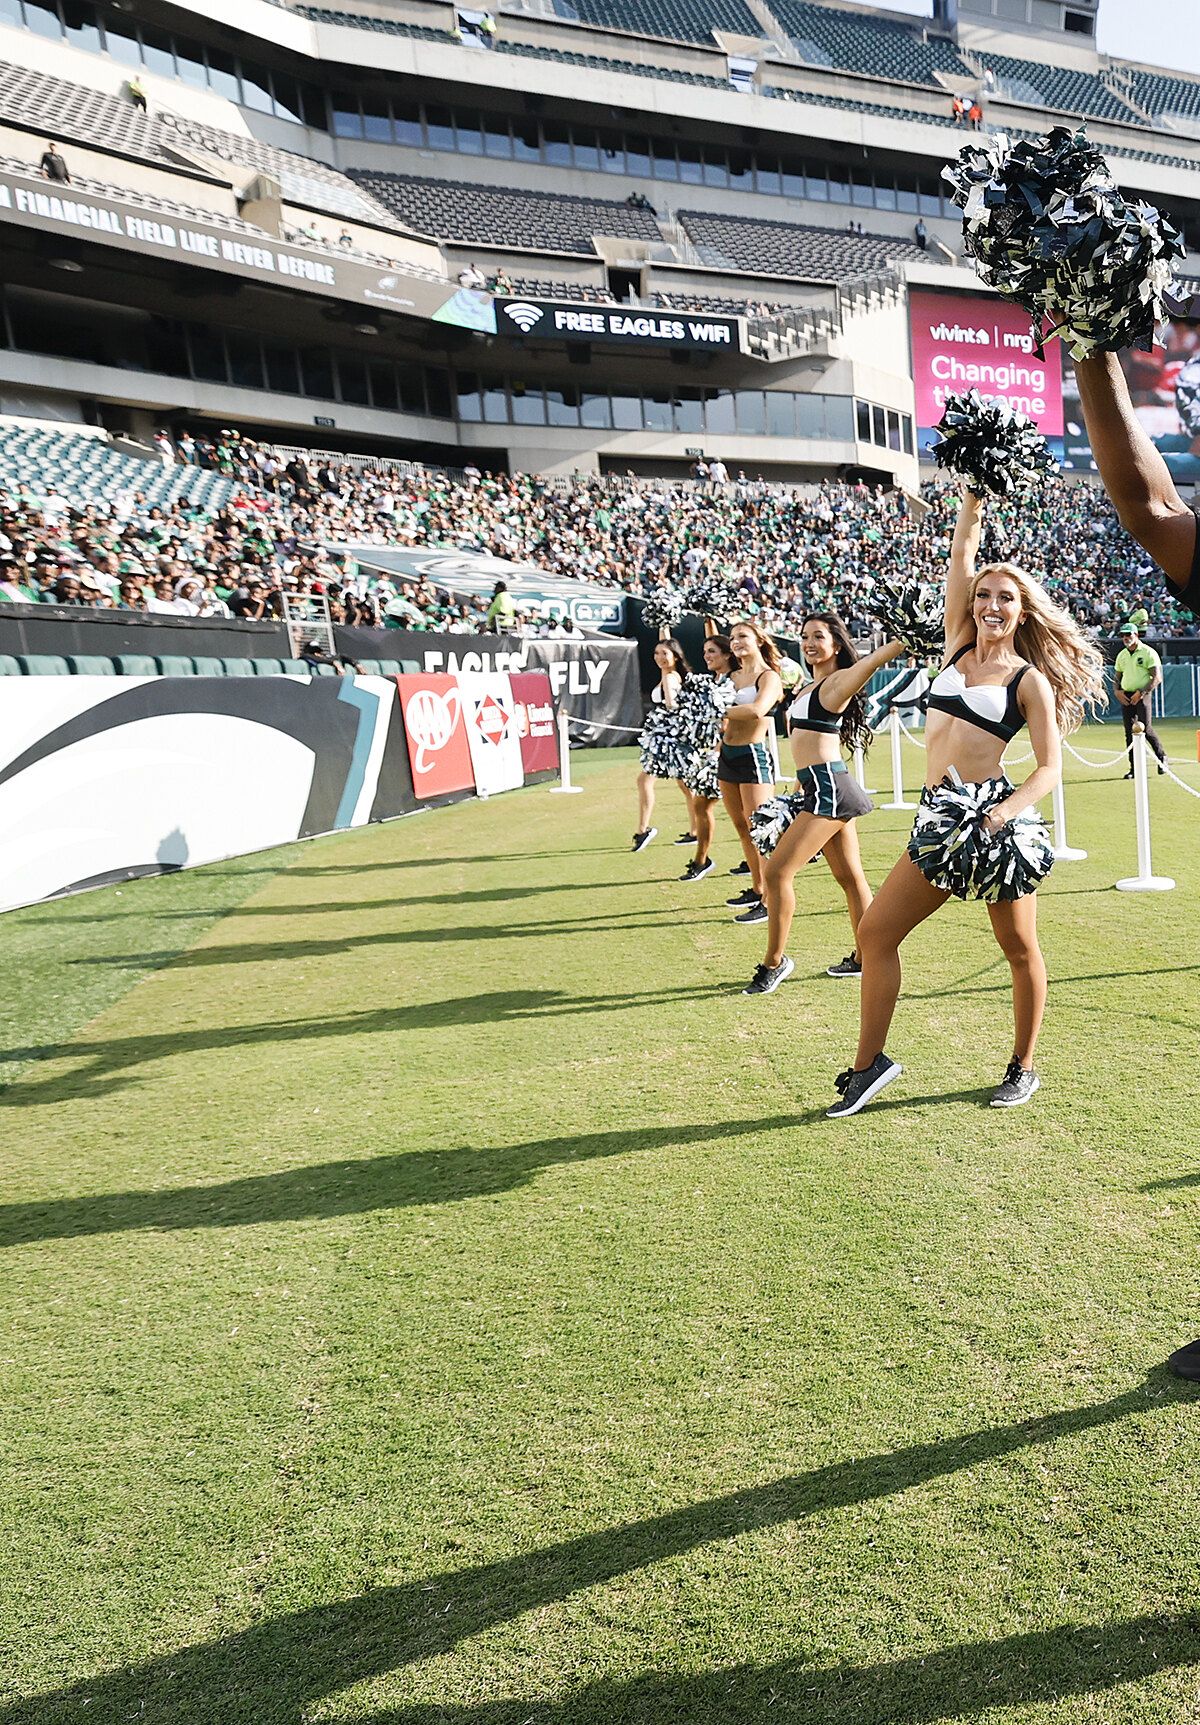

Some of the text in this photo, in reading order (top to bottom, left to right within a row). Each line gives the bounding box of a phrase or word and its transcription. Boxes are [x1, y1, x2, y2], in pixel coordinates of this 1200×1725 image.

[14, 187, 126, 236] FINANCIAL
[125, 215, 178, 248] FIELD
[178, 228, 220, 258] LIKE
[221, 238, 276, 272] NEVER
[276, 253, 336, 286] BEFORE
[554, 310, 731, 344] FREE EAGLES WIFI
[929, 322, 976, 344] vivint
[1003, 332, 1033, 354] nrg
[931, 355, 1046, 393] Changing
[549, 659, 610, 697] FLY
